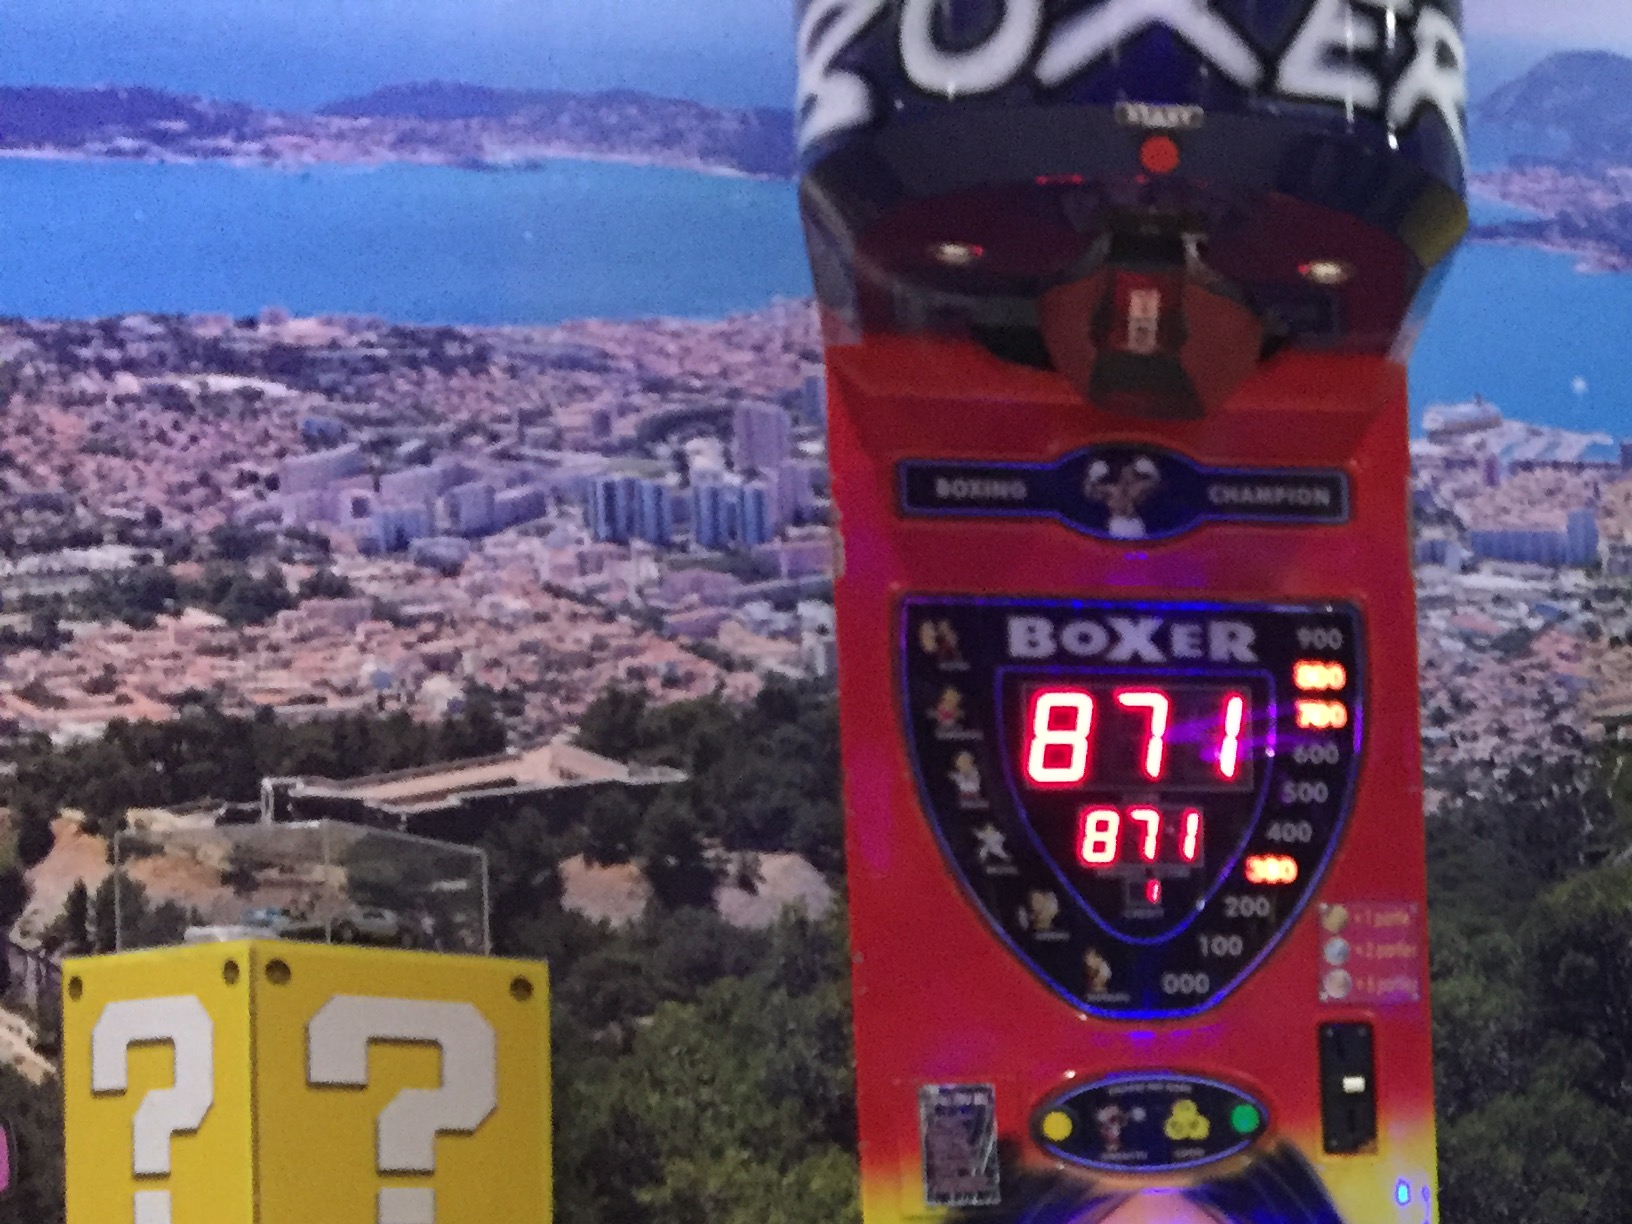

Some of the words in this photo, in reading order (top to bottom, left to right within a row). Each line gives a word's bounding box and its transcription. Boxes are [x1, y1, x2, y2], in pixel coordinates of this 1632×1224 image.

[935, 478, 1027, 499] BOXING
[1208, 484, 1330, 505] CHAMPION
[1006, 615, 1258, 662] BOXER
[1298, 627, 1343, 650] 900
[1026, 688, 1246, 785] 871
[1293, 741, 1339, 765] 600
[1282, 781, 1328, 803] 500
[1081, 806, 1201, 865] 871
[1266, 821, 1312, 843] 400
[1224, 896, 1270, 918] 200
[1201, 934, 1243, 956] 100
[1161, 972, 1210, 994] 000
